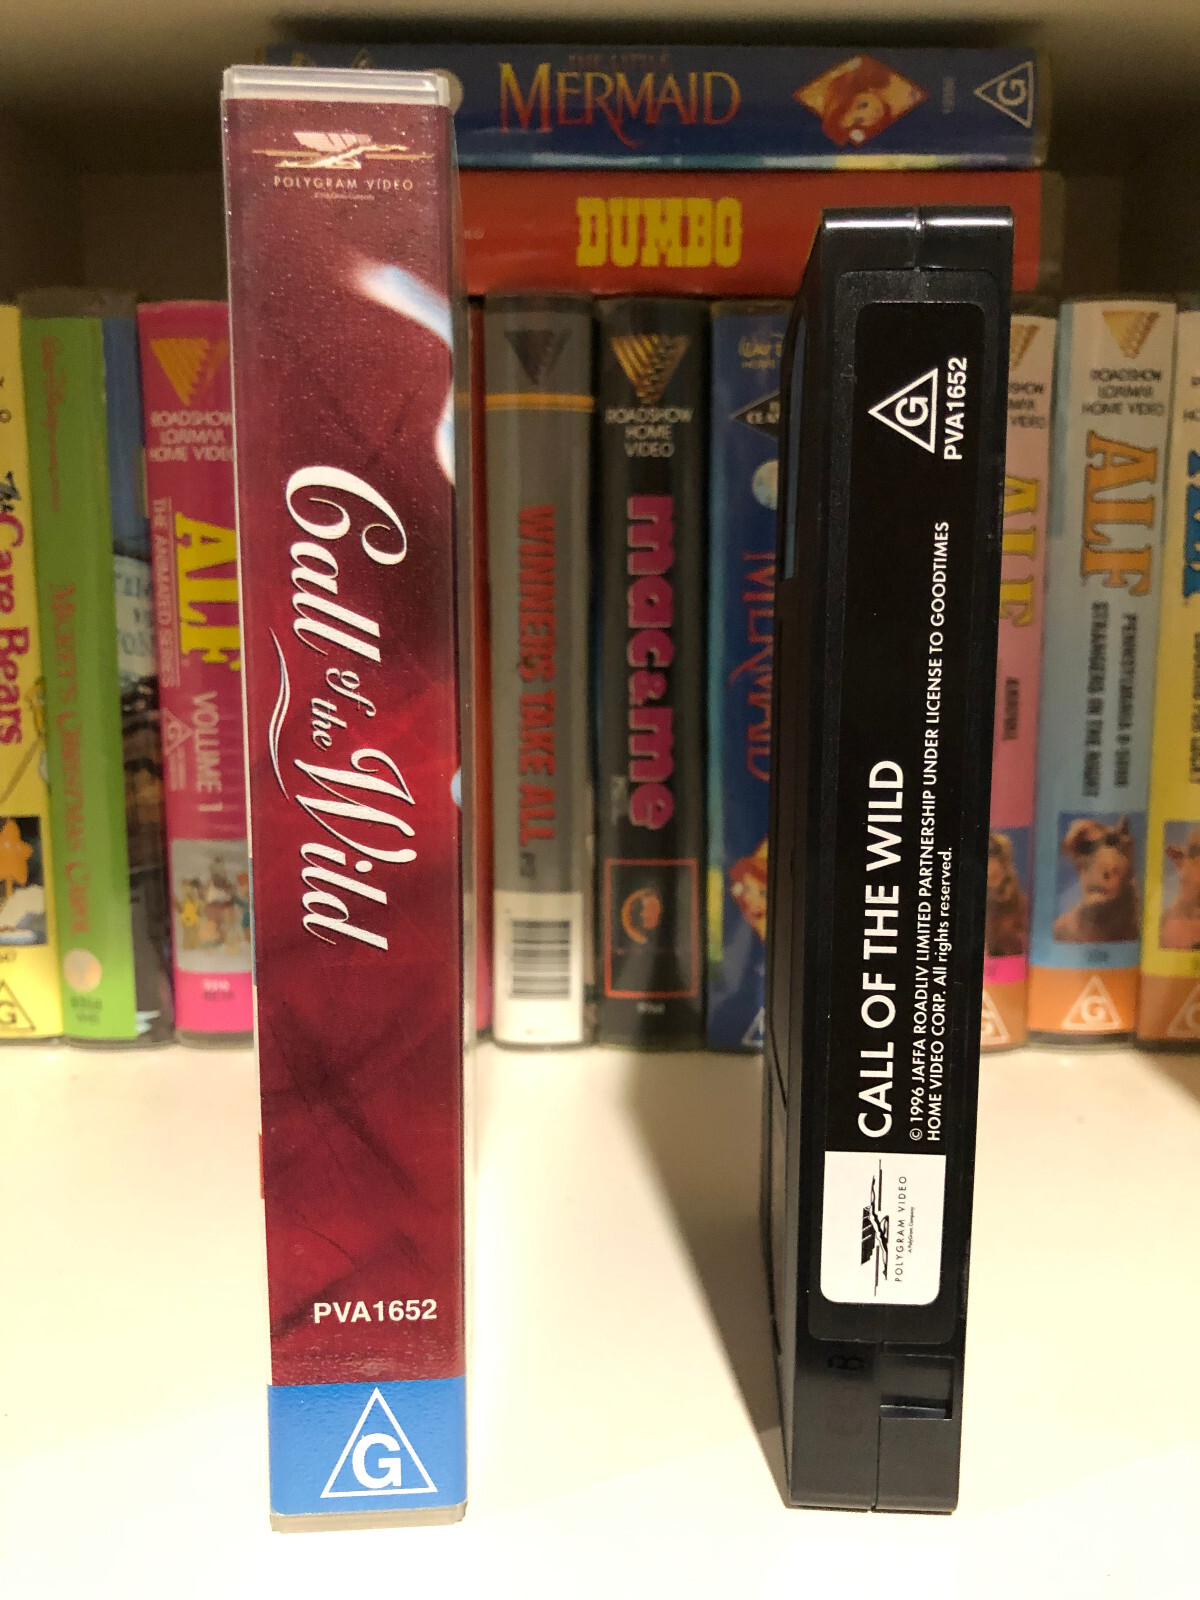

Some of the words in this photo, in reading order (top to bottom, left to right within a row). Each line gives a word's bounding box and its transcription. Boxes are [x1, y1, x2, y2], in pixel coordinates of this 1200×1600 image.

[498, 62, 742, 149] MERMAID
[996, 79, 1027, 106] G
[273, 175, 358, 189] POLYGRAM
[366, 178, 414, 192] VIDEO
[576, 198, 742, 267] DUMBO
[605, 407, 693, 424] ROADSHOW
[624, 425, 672, 440] HOME
[895, 396, 929, 427] G
[943, 356, 968, 461] PVA1652
[624, 443, 676, 458] VIDEO
[1082, 430, 1158, 597] ALF
[174, 511, 241, 672] ALF
[285, 465, 408, 663] Call
[518, 504, 557, 682] WINNERS
[931, 521, 949, 627] GOODTIMES
[929, 631, 944, 655] TO
[325, 667, 377, 718] of
[926, 658, 942, 724] LICENSE
[192, 689, 223, 794] VOLUME
[309, 697, 347, 751] the
[519, 690, 557, 776] TAKE
[922, 728, 938, 786] UNDER
[519, 784, 556, 845] ALL
[866, 760, 904, 872] WILD
[918, 789, 936, 897] PARTNERSHIP
[294, 747, 418, 951] Wild
[938, 846, 952, 917] reserved.
[863, 884, 899, 961] THE
[915, 901, 931, 961] LIMITED
[934, 921, 953, 962] rights
[860, 972, 897, 1029] OF
[913, 966, 929, 1035] ROADLIV
[933, 966, 947, 987] All
[932, 988, 946, 1037] CORP.
[1080, 994, 1106, 1022] G
[857, 1041, 894, 1138] CALL
[911, 1038, 927, 1085] JAFFA
[929, 1040, 944, 1090] VIDEO
[910, 1086, 924, 1123] 1996
[927, 1093, 942, 1141] HOME
[897, 1175, 907, 1213] VIDEO
[894, 1218, 906, 1283] POLYGRAM
[313, 1298, 438, 1324] PVA1652
[352, 1432, 402, 1489] G
